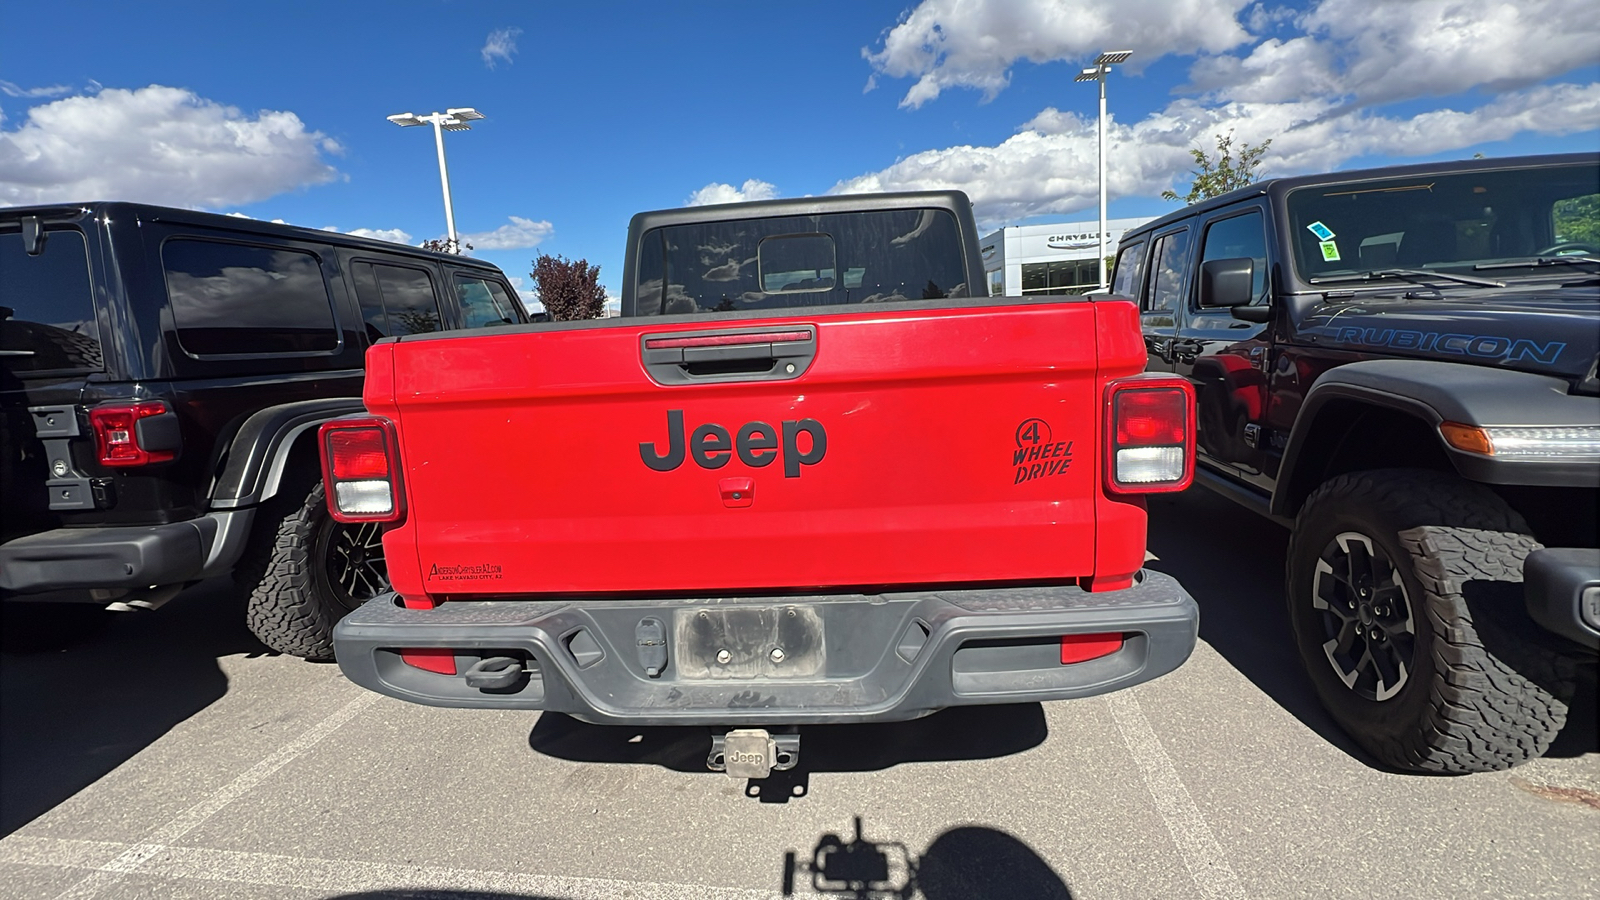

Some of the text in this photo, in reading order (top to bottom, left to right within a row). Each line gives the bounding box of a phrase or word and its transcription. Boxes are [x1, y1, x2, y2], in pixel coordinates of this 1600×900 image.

[1335, 326, 1567, 364] RUBICON
[639, 409, 827, 478] Jeep
[1021, 422, 1041, 445] 4
[1013, 441, 1074, 466] WHEEL
[1014, 459, 1073, 485] DRIVE
[730, 751, 764, 765] Jeep
